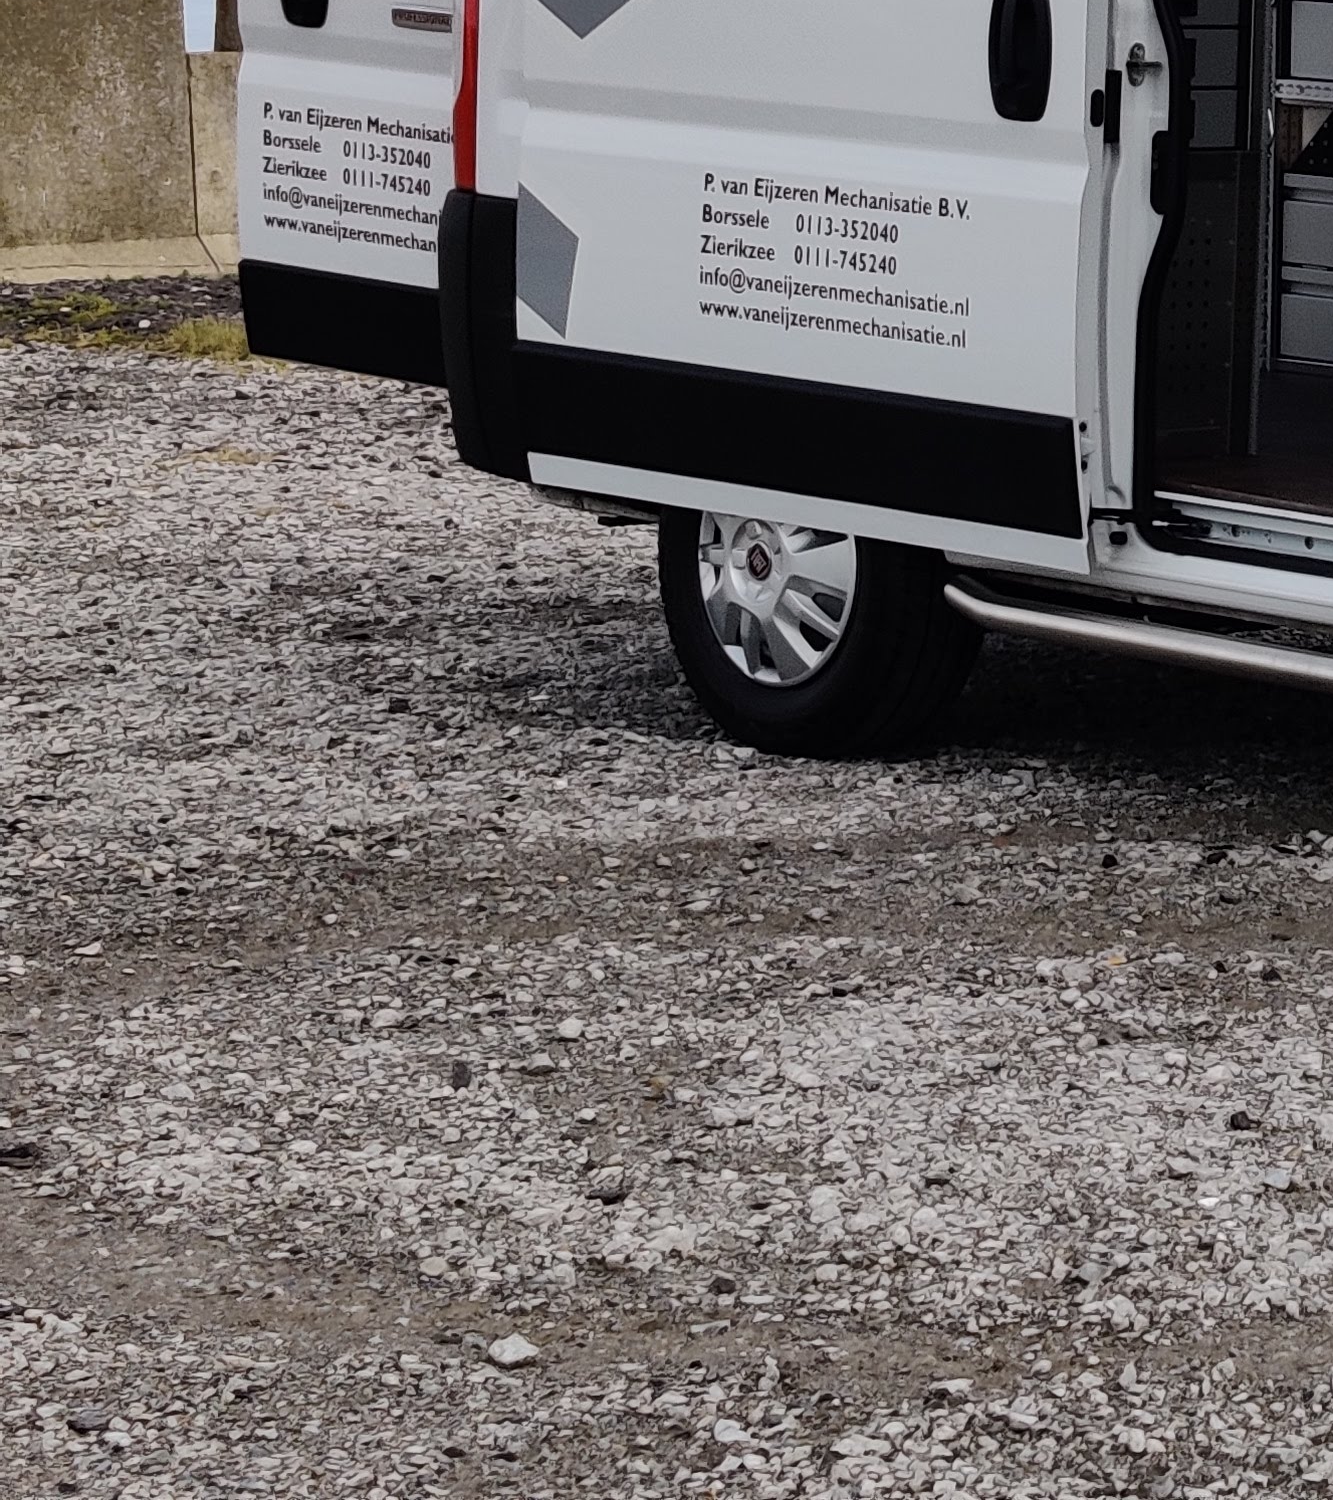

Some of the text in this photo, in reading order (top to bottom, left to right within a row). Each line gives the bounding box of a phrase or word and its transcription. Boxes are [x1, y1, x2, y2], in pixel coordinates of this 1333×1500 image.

[264, 102, 454, 145] P. van Eijzeren Mechanisati
[263, 129, 431, 169] Borssele 0113-352040
[262, 156, 431, 197] Zierikzee 0111-745240
[704, 173, 970, 220] P. van Eijzeren Mechanisatie B.V.
[702, 204, 899, 244] Borssele 0113-352040
[700, 234, 897, 275] Zierikzee 0111-745240
[699, 266, 970, 317] info@vaneijzerenmechanisatie.nl
[699, 300, 966, 348] www.vaneijzerenmechanisatie.nl
